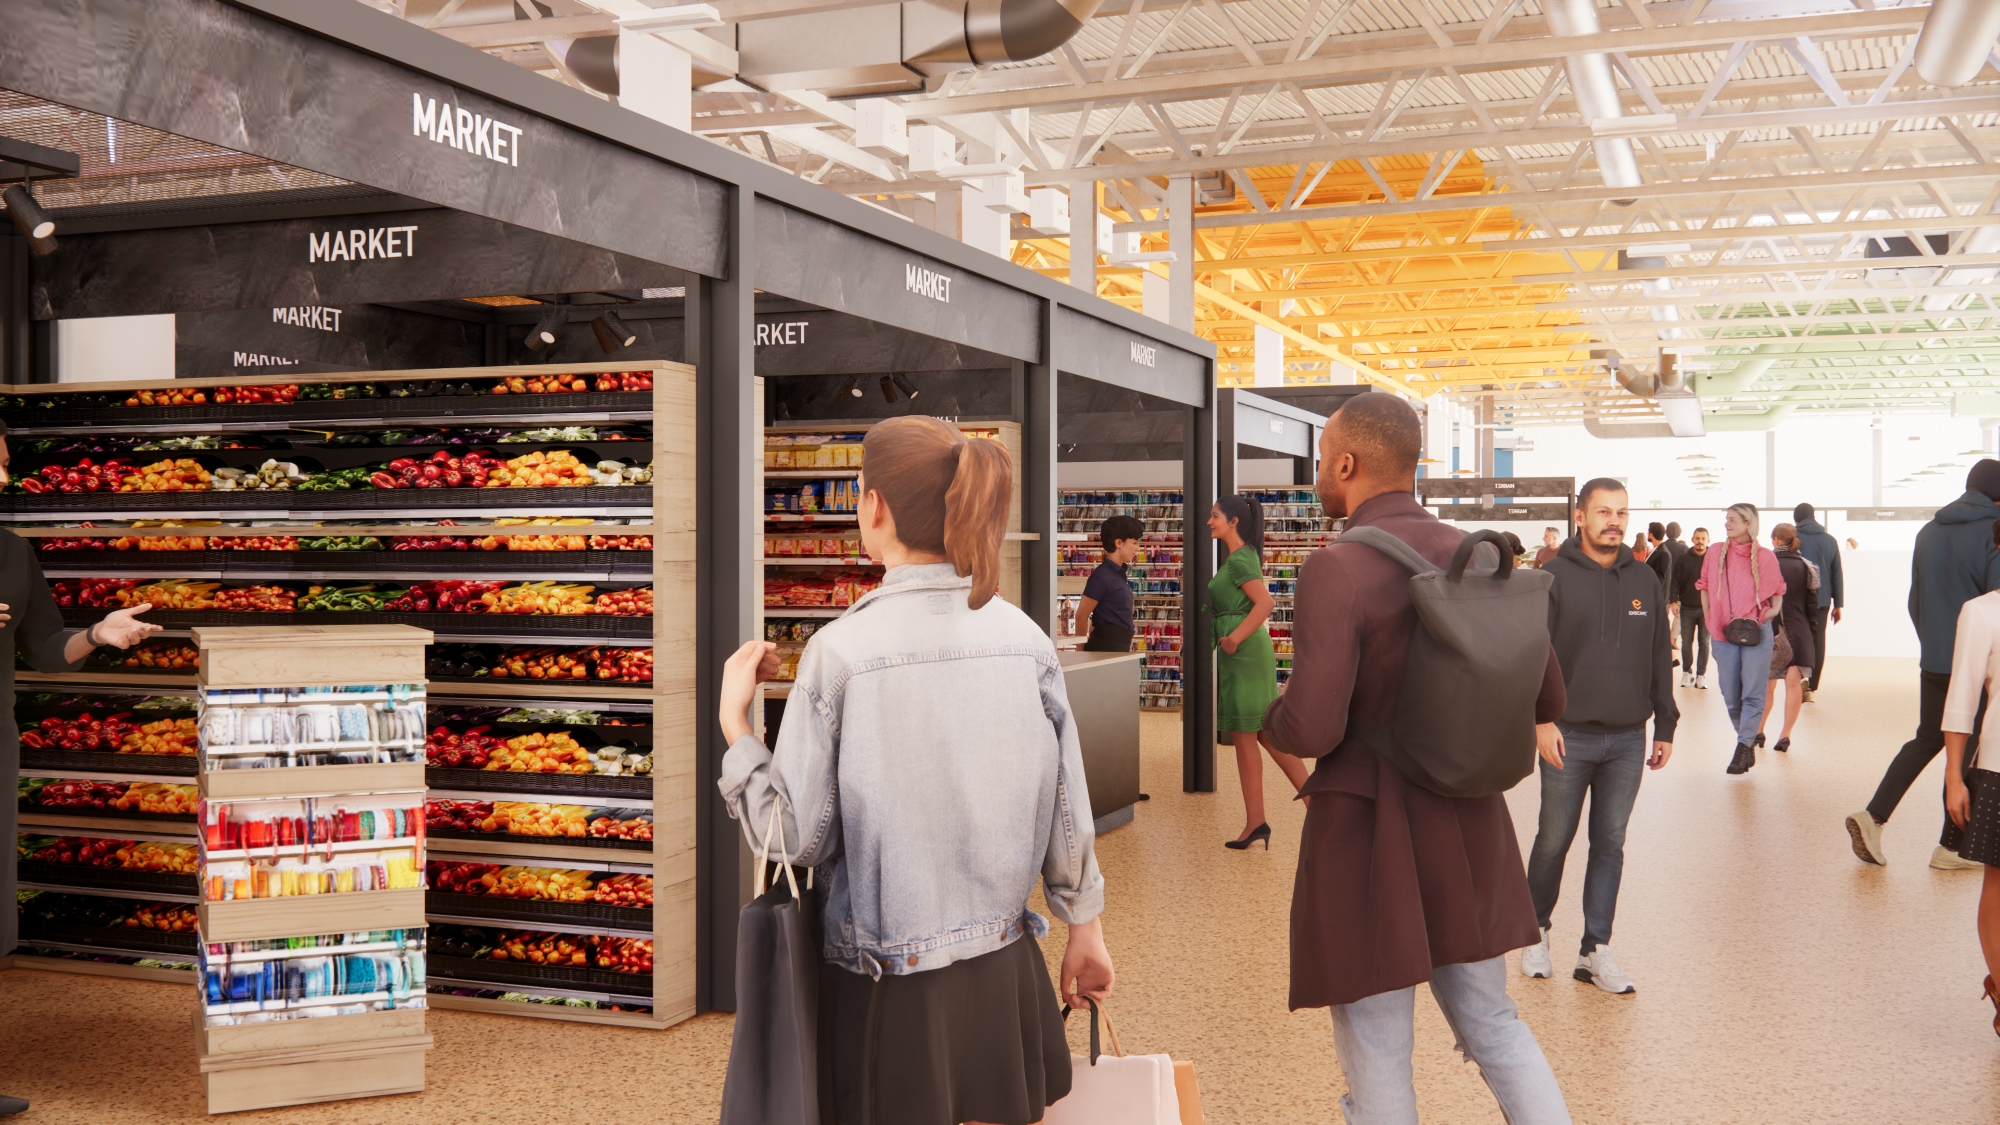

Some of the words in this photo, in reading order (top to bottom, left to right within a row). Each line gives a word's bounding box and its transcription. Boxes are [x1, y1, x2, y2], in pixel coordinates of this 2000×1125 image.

[413, 92, 523, 168] MARKET
[309, 225, 419, 263] MARKET
[905, 263, 952, 304] MARKET
[272, 305, 343, 333] MARKET
[753, 321, 809, 346] RKET
[1130, 341, 1156, 368] MARKET
